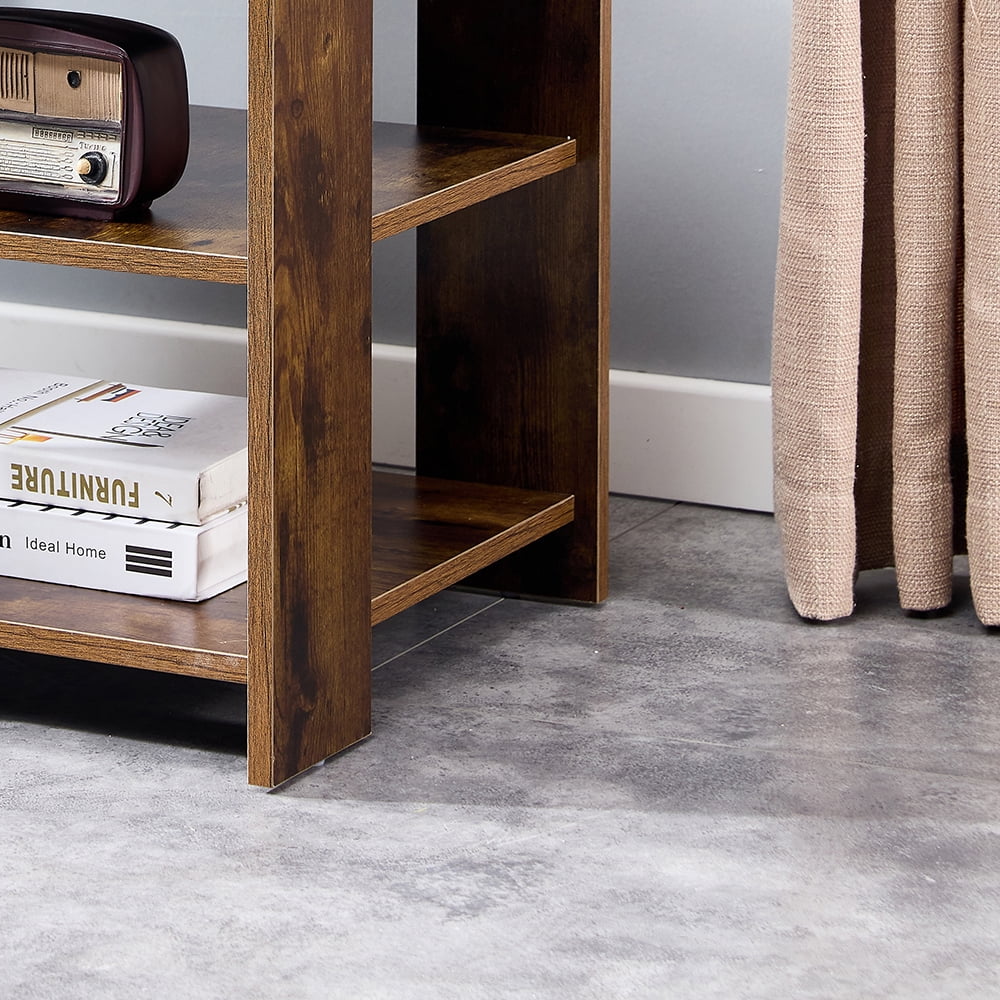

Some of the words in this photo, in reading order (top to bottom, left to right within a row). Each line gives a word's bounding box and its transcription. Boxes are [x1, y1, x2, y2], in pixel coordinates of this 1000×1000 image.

[10, 463, 140, 508] FURNITURE
[25, 536, 60, 553] Ideal
[65, 542, 107, 560] Home
